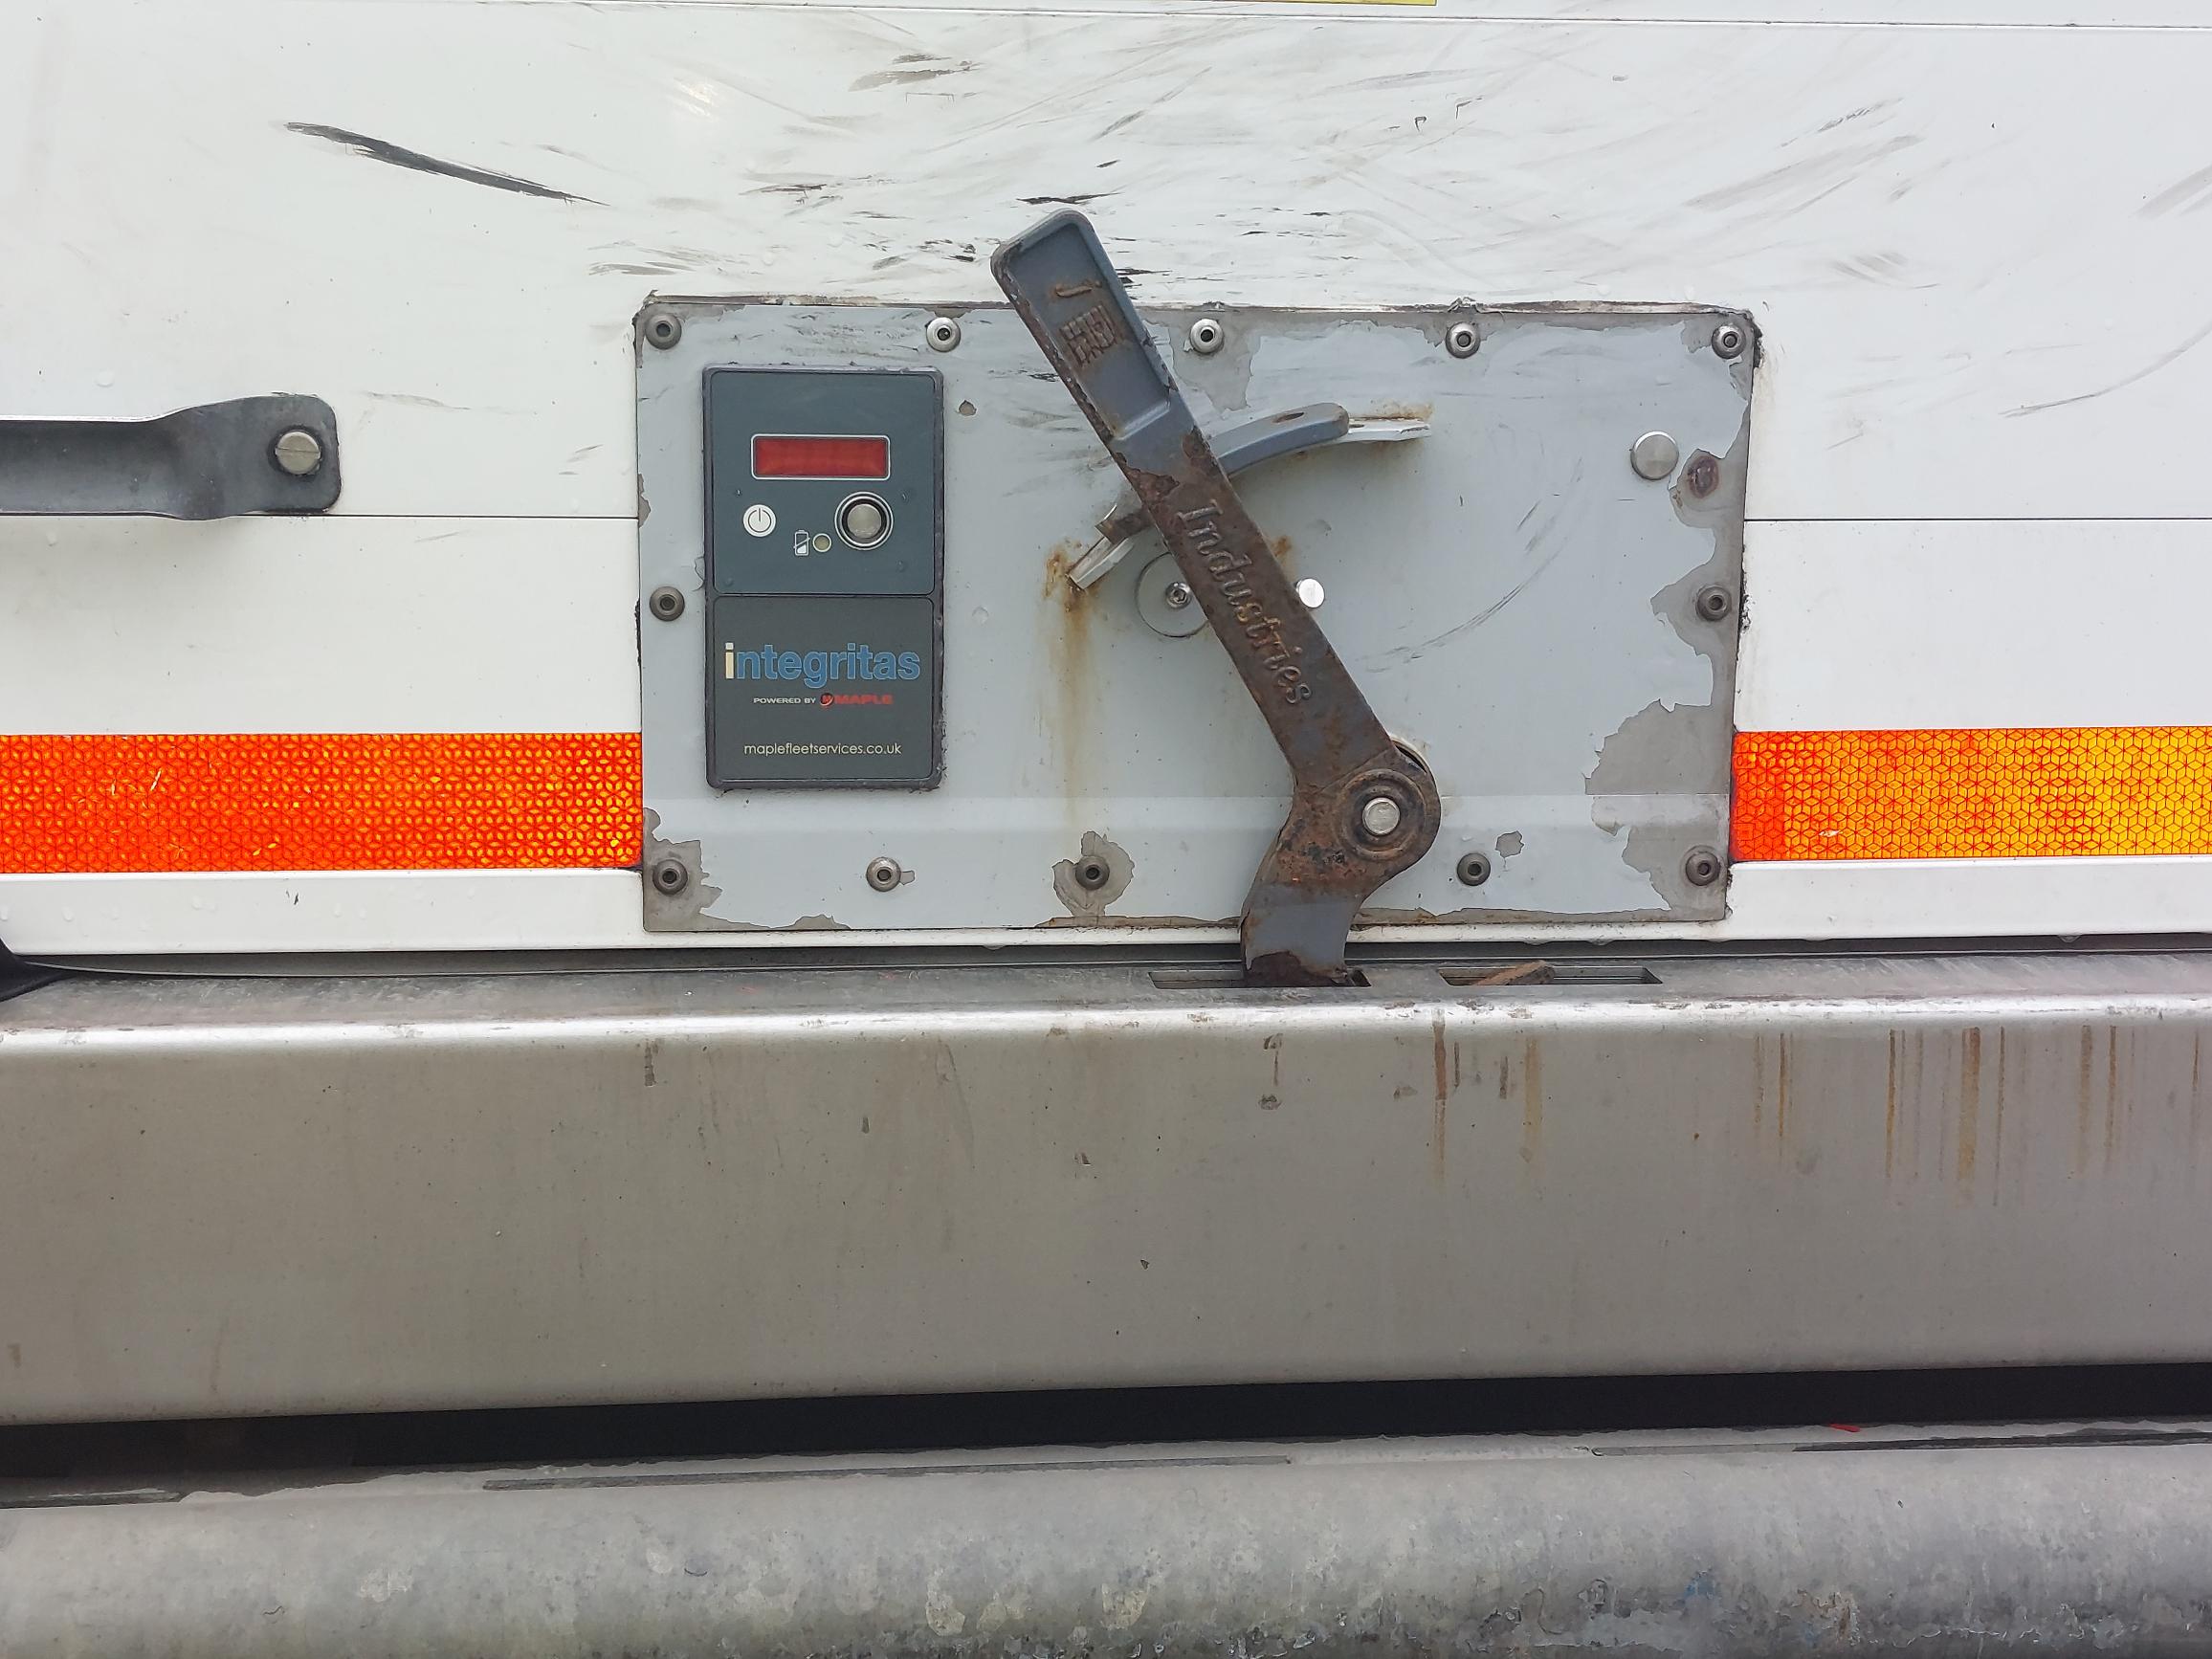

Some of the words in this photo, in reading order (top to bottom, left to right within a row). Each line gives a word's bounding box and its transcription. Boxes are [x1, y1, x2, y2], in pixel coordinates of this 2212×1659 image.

[1176, 498, 1312, 704] Industries
[725, 642, 920, 689] integritas
[834, 695, 893, 705] MAPLE
[743, 742, 902, 757] maplefleetservices.co.uk
